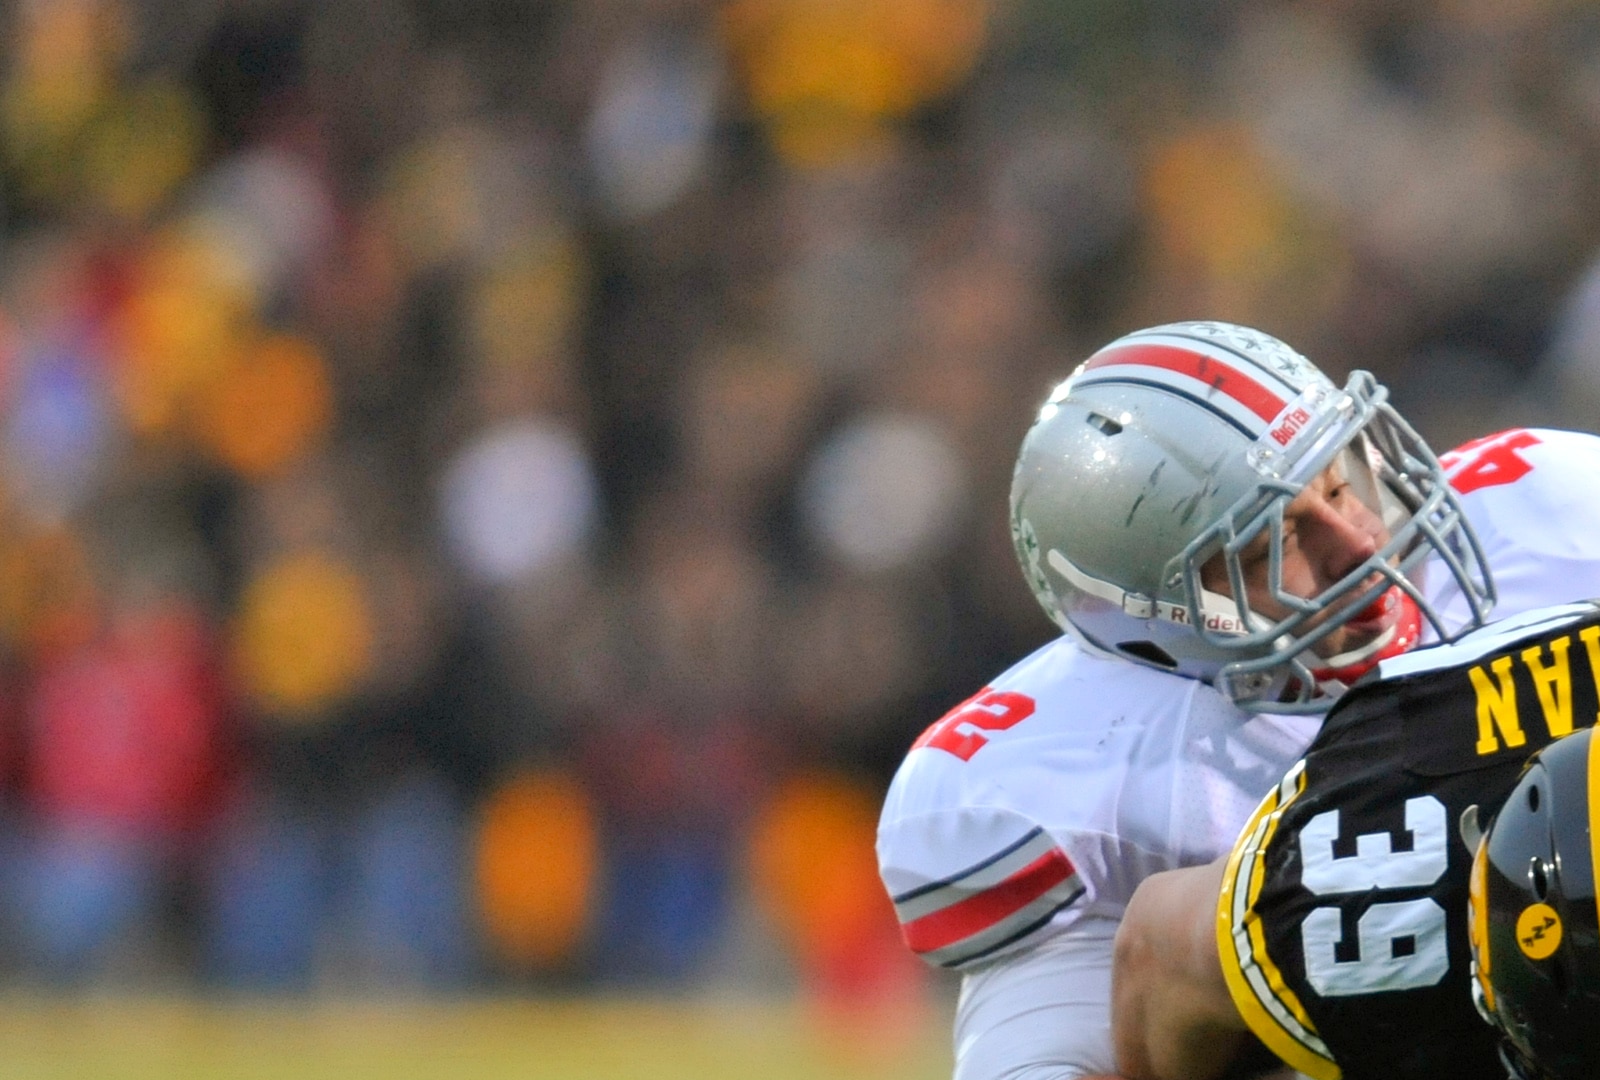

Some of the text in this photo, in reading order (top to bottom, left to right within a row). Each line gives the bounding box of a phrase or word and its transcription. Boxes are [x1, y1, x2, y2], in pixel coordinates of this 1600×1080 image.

[911, 686, 1036, 762] 2
[1299, 795, 1449, 997] 39
[1522, 916, 1556, 948] ANF
